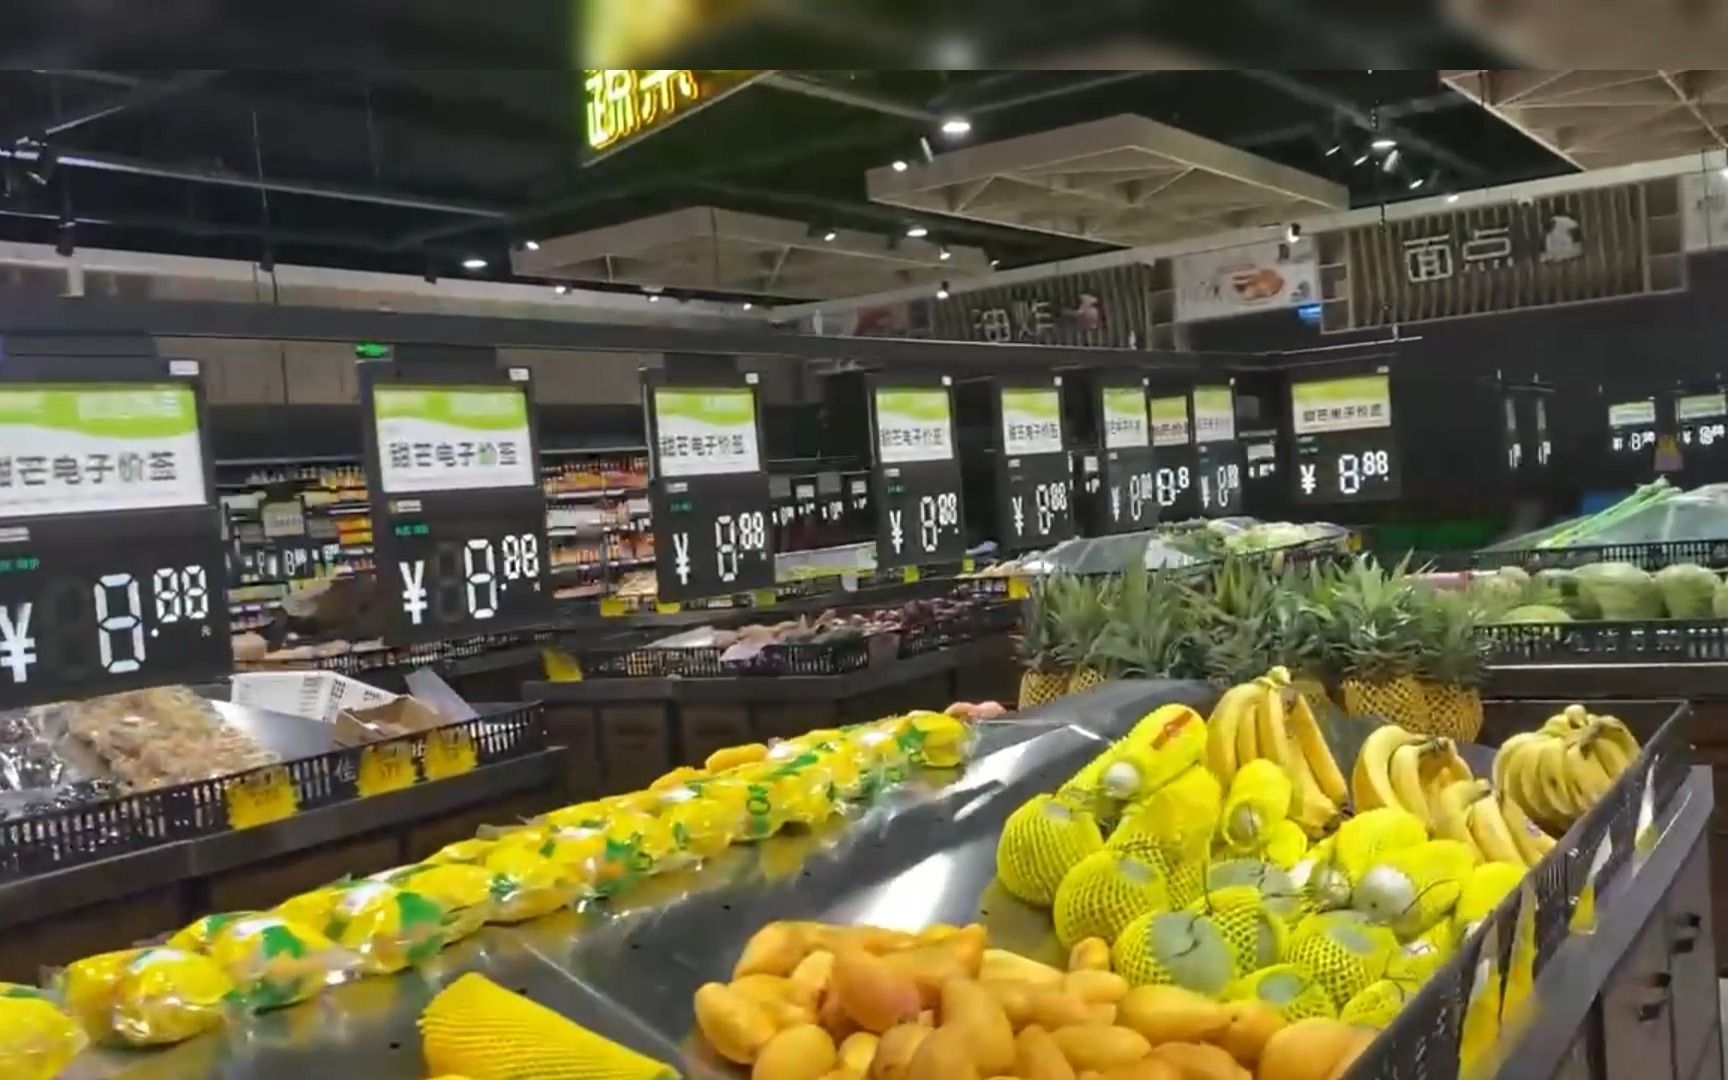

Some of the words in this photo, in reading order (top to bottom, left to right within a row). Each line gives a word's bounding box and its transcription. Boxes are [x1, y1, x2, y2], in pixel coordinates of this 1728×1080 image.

[1402, 227, 1515, 283] 面点
[389, 442, 517, 468] 甜芒电子价签
[1300, 464, 1316, 494] ¥
[1338, 450, 1389, 494] 8.88
[889, 509, 903, 555] ¥
[920, 492, 957, 552] 8.88
[1012, 495, 1024, 536] ¥
[1035, 481, 1067, 535] 8.88
[672, 532, 691, 585] ¥
[715, 511, 765, 582] 8.88
[399, 560, 428, 625] ¥
[464, 533, 540, 619] 8.88
[94, 564, 209, 673] 8.88
